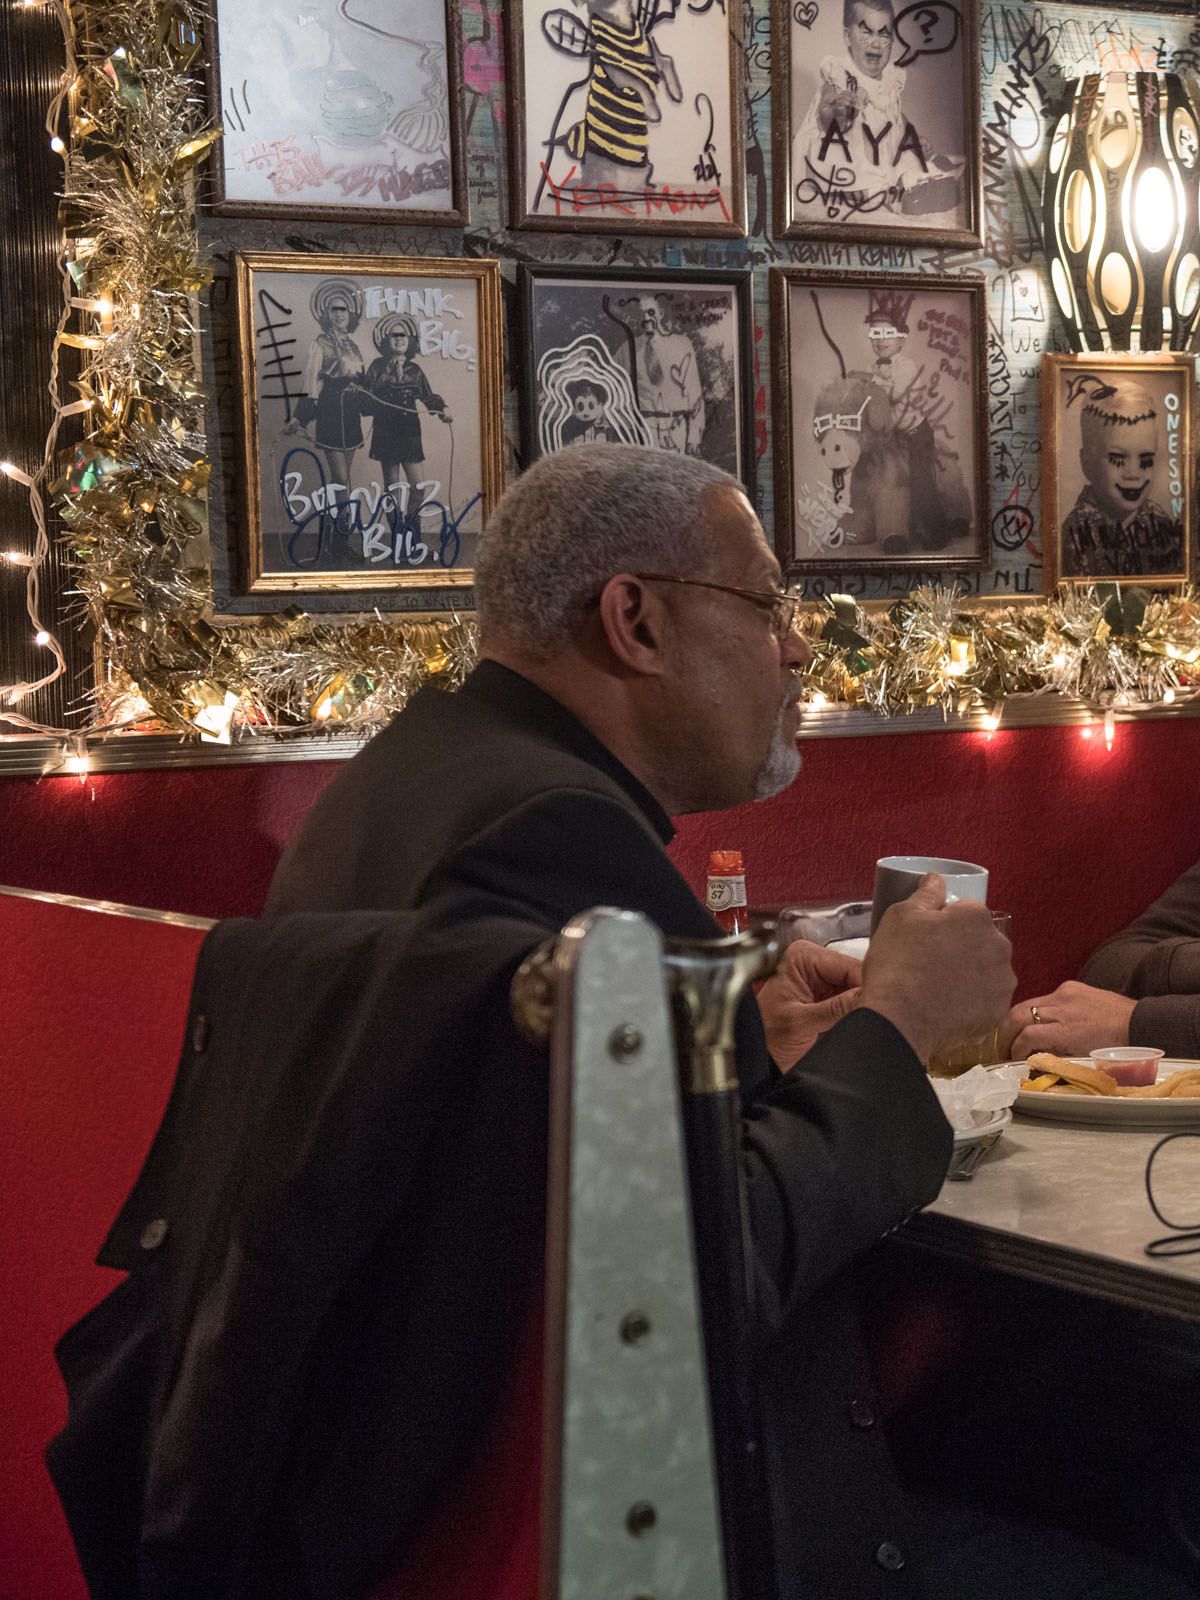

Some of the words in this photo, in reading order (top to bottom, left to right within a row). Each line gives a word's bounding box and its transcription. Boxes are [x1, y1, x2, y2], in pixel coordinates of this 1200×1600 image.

[817, 118, 929, 173] AYA
[540, 162, 636, 216] YER
[786, 241, 851, 266] KEMIST
[858, 244, 915, 268] KEMIST
[711, 890, 724, 899] 57
